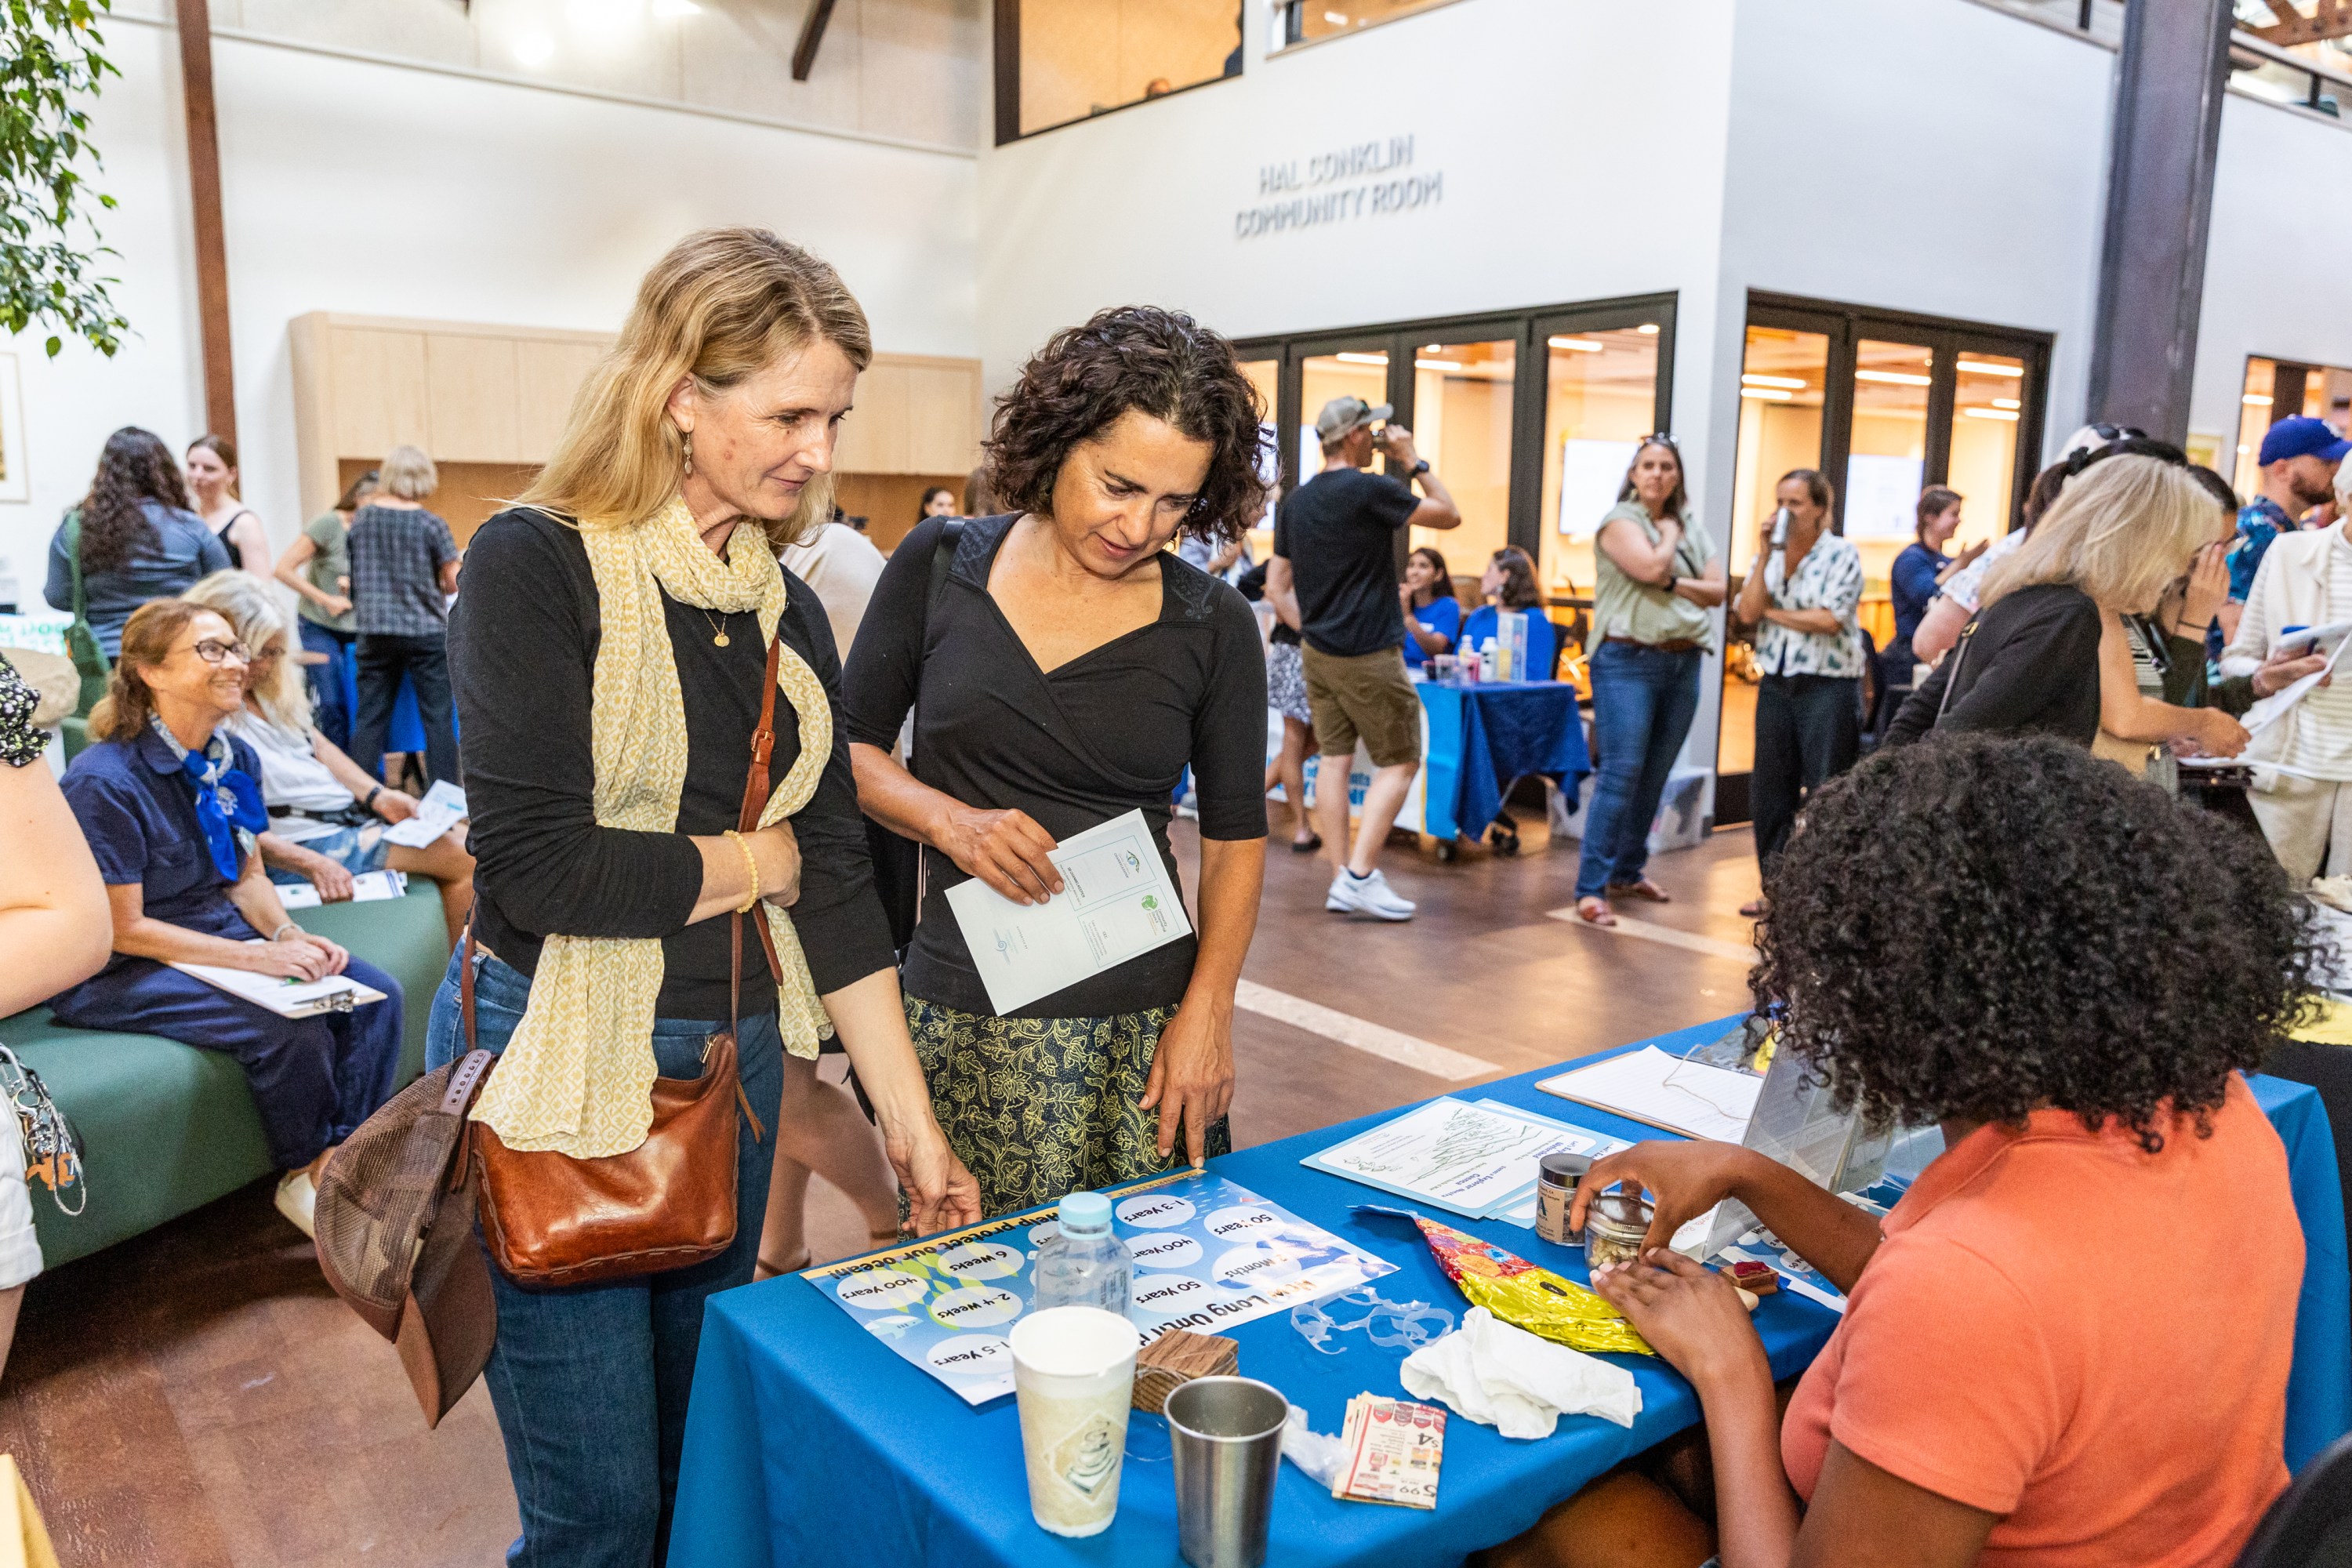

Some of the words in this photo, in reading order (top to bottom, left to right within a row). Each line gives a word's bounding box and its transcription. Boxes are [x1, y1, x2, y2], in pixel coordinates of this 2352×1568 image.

[1259, 161, 1303, 196] HAL
[1308, 133, 1414, 189] CONKLIN
[1235, 186, 1367, 239] COMMUNITY
[1372, 169, 1444, 214] ROOM
[1455, 1173, 1480, 1185] Cuenca
[1462, 1174, 1494, 1190] Explorar
[1161, 1200, 1185, 1210] 1-3
[1018, 1211, 1060, 1228] Help
[1124, 1206, 1163, 1222] Years
[1250, 1214, 1272, 1224] 50
[938, 1221, 1017, 1250] protect
[1214, 1219, 1254, 1236] Years
[1163, 1238, 1192, 1251] 400
[902, 1246, 937, 1261] our
[1132, 1247, 1163, 1260] Year
[829, 1256, 897, 1280] ocean!
[949, 1255, 996, 1272] Weeks
[1225, 1258, 1275, 1278] Months
[884, 1277, 918, 1288] 400
[1177, 1281, 1202, 1292] 50
[842, 1287, 884, 1299] Years
[983, 1293, 1011, 1306] 2-4
[1135, 1287, 1175, 1304] Years
[937, 1302, 982, 1319] Weeks
[1206, 1294, 1270, 1317] Long
[933, 1350, 982, 1366] Years
